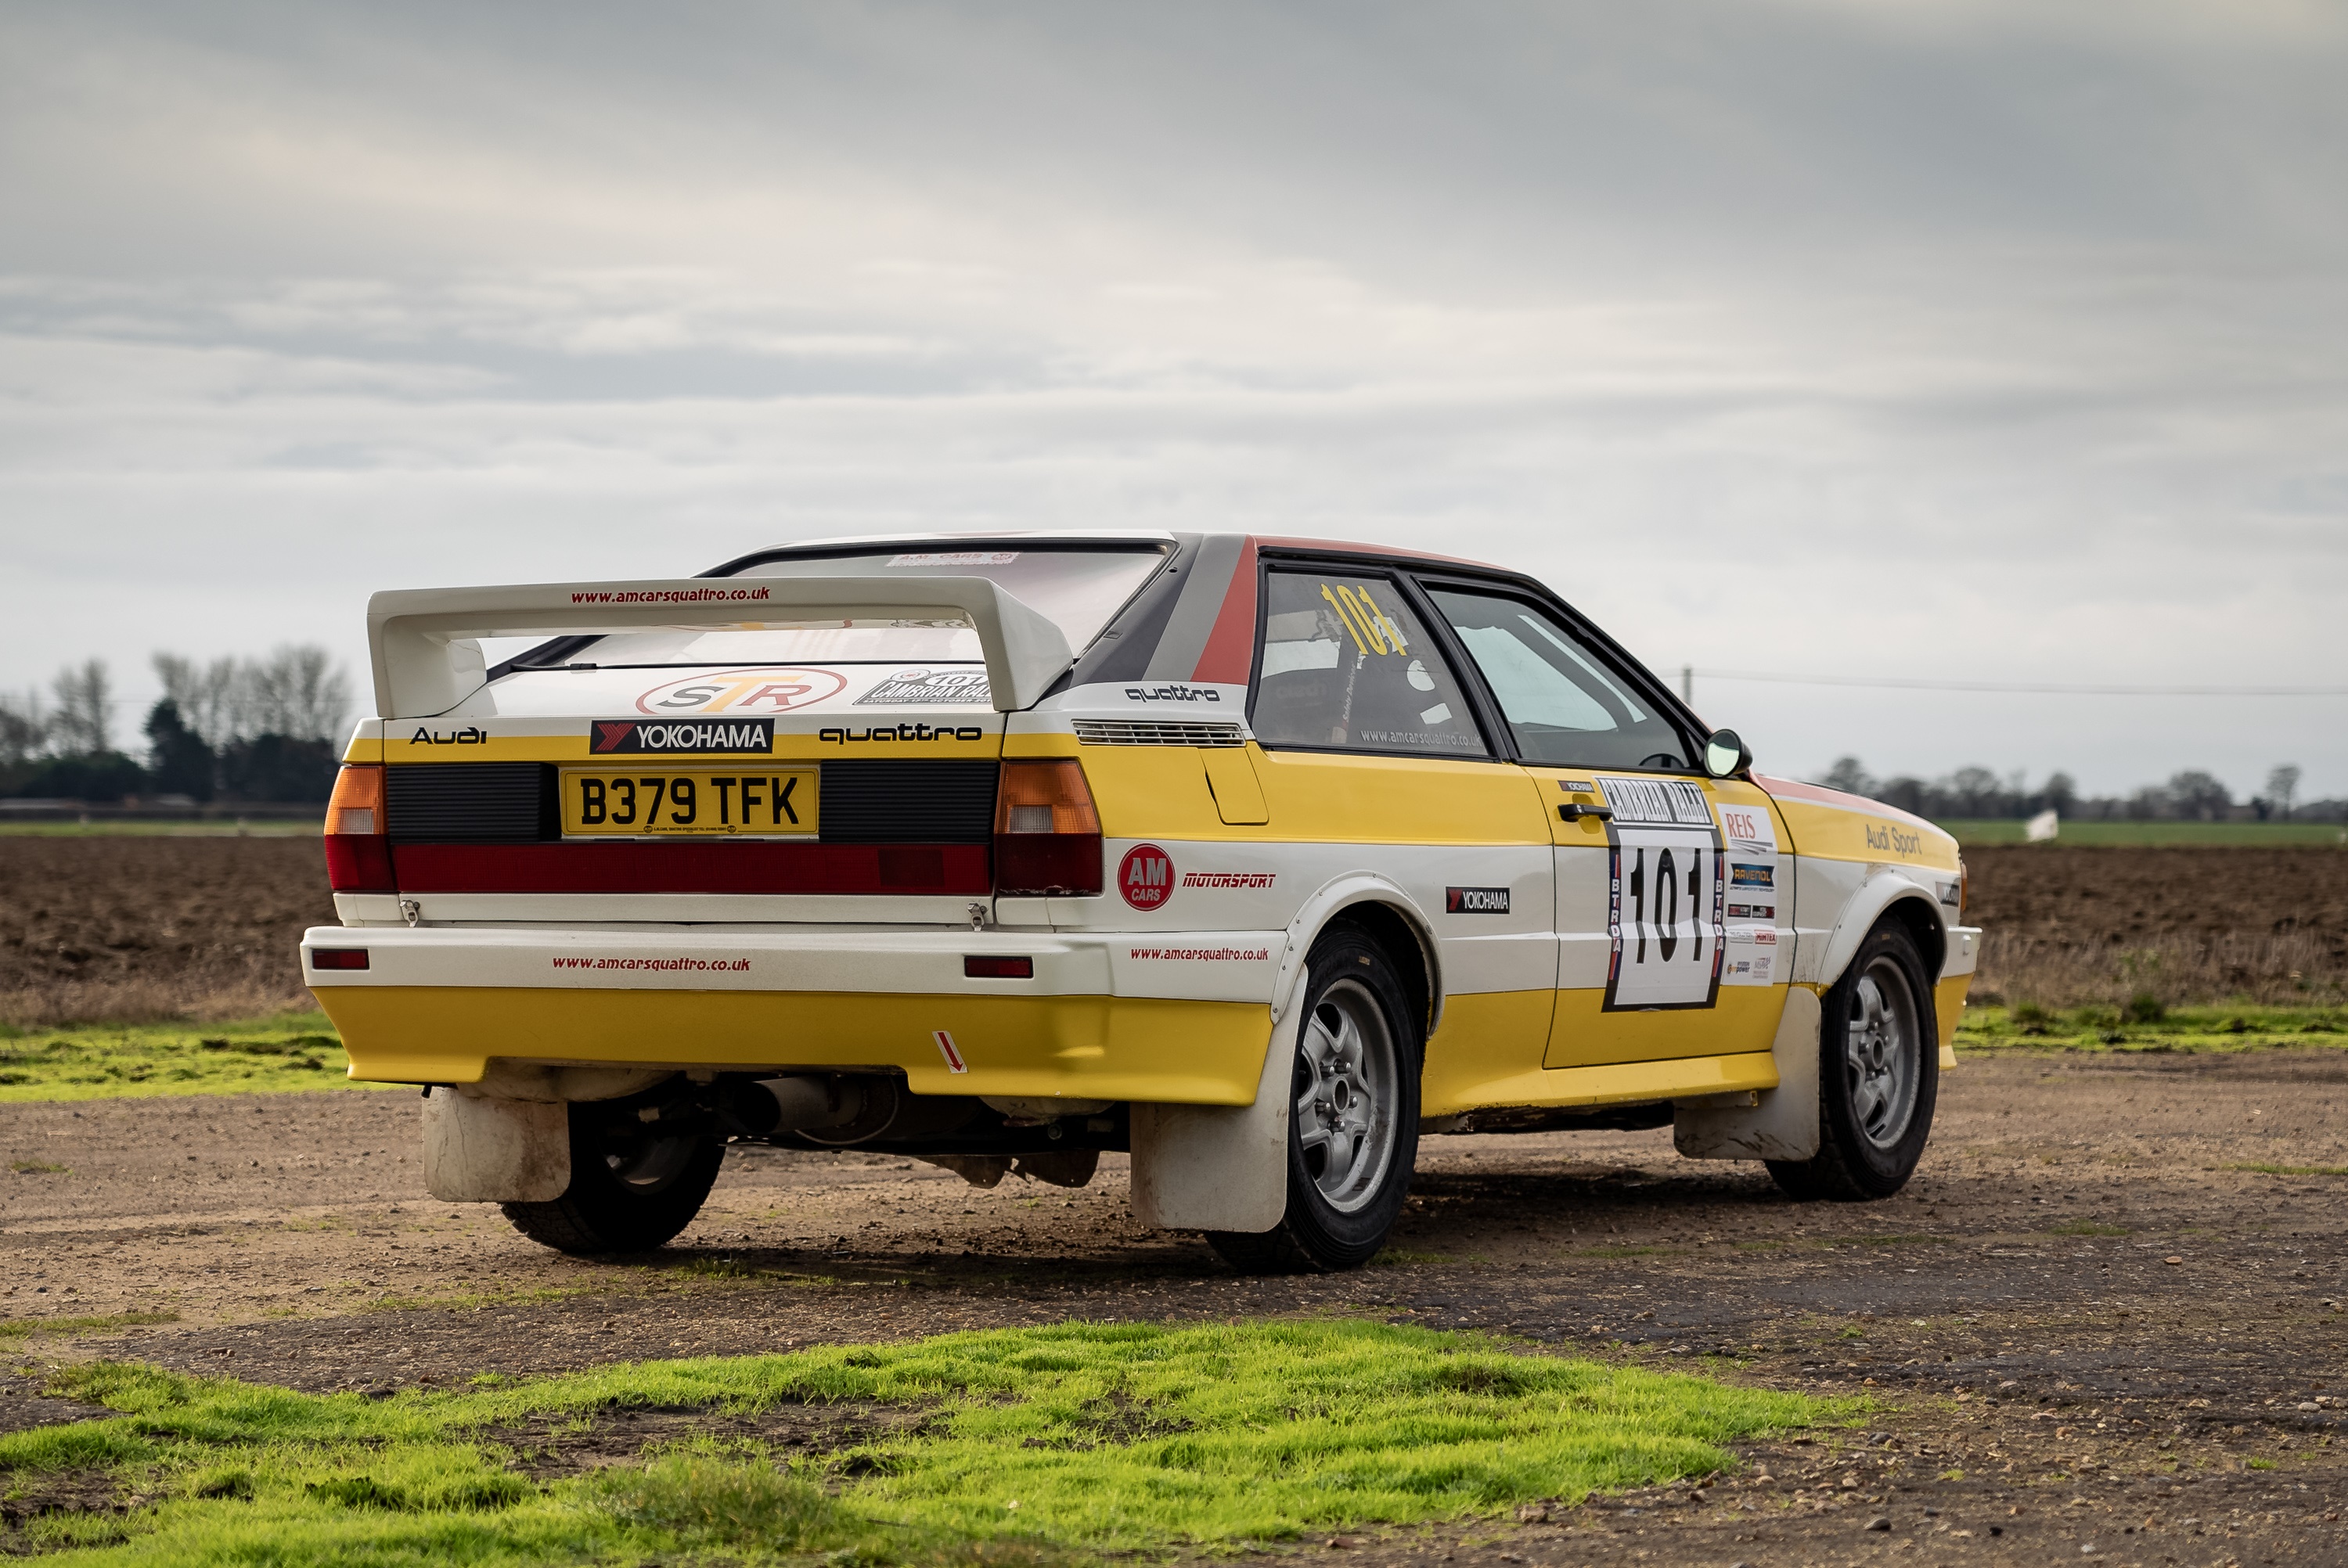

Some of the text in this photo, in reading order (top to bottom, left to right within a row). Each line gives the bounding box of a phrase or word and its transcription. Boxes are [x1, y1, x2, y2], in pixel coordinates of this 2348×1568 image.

[571, 586, 770, 604] www.amcarsquattro.co.uk
[1320, 583, 1407, 656] 101
[870, 681, 962, 698] CAMBRIAN
[935, 676, 983, 685] 101
[656, 674, 812, 713] STR
[1125, 685, 1221, 703] quattro
[409, 727, 487, 745] Audi
[636, 724, 765, 748] YOKOHAMA
[819, 723, 983, 745] quattro
[1360, 729, 1483, 747] www.amcarsquattro.co.uk
[1567, 782, 1594, 792] YOKOHAMA
[581, 777, 800, 825] B379 TFK
[1599, 778, 1711, 824] CAMBRIAN RALLY
[1726, 813, 1756, 840] REIS
[1866, 824, 1922, 858] Audi Sport
[1127, 858, 1167, 886] AM
[1182, 873, 1277, 888] MOTORSPORT
[1734, 869, 1771, 882] RAVENOL
[1132, 889, 1161, 901] CARS
[1462, 891, 1508, 909] YOKOHAMA
[1630, 847, 1702, 964] 101
[1611, 879, 1621, 952] BTRDA
[1715, 879, 1724, 951] BTRDA
[553, 956, 751, 972] www.amcarsquattro.co.uk
[1130, 948, 1269, 962] www.amcarsquattro.co.uk
